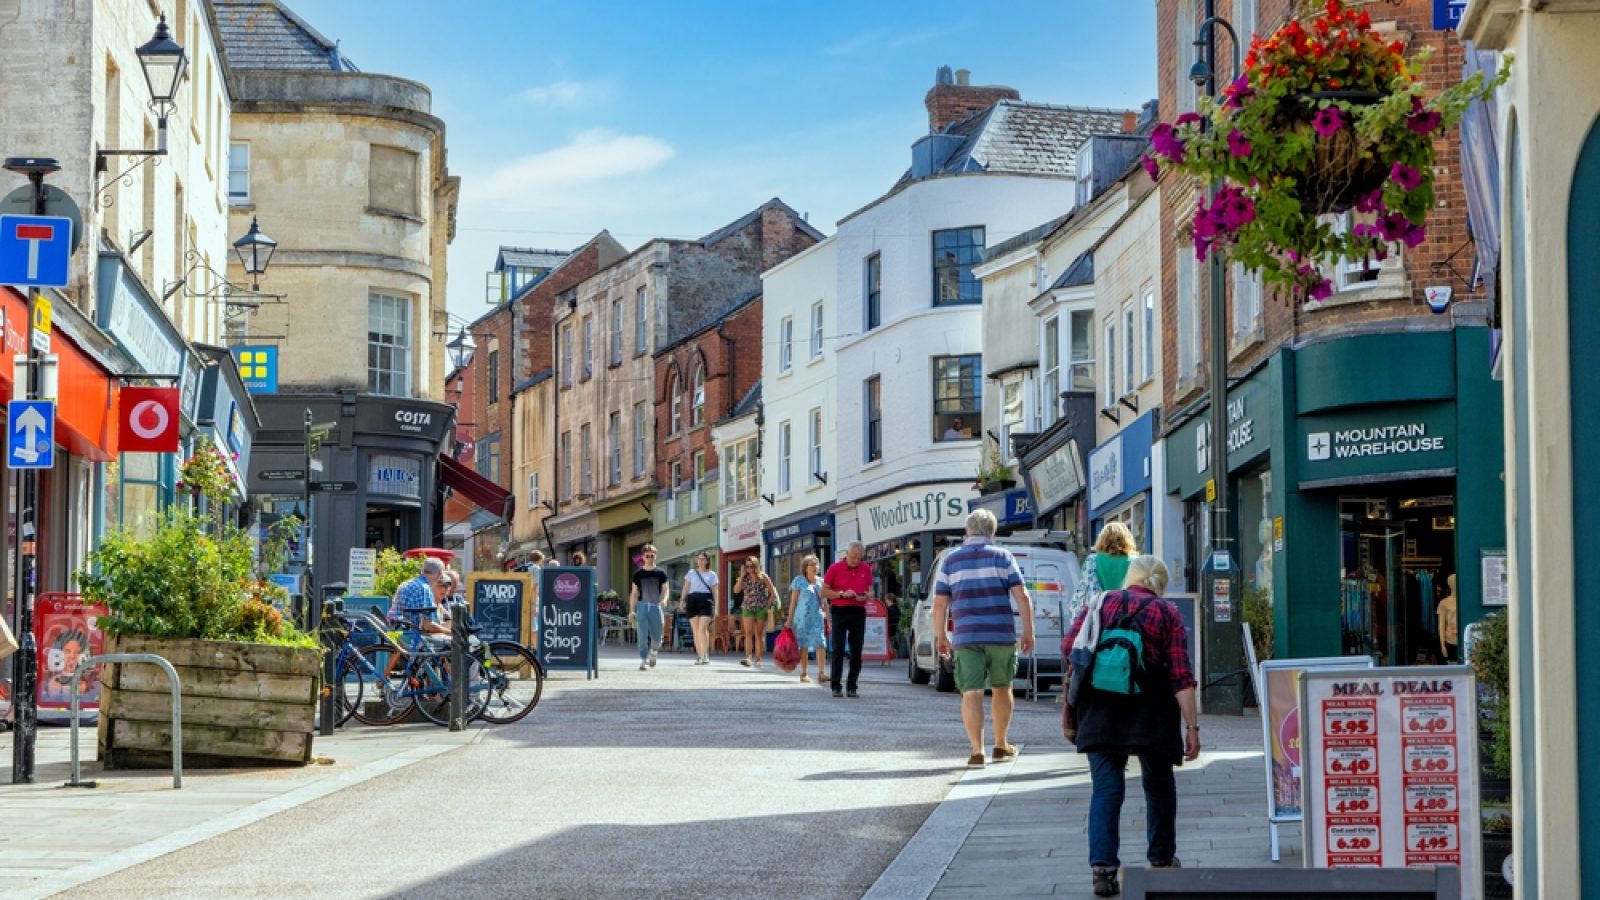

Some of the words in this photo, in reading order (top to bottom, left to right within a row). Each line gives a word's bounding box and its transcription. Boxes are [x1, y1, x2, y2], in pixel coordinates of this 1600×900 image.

[395, 411, 431, 424] COSTA
[1335, 423, 1425, 443] MOUNTAIN
[1335, 437, 1444, 458] WAREHOUSE
[869, 492, 963, 531] Woodruffs
[483, 584, 516, 599] YARD
[543, 604, 582, 626] Wine
[543, 627, 581, 654] Shop
[1332, 682, 1385, 696] MEAL
[1392, 680, 1453, 695] DEALS
[1331, 720, 1368, 734] 5.95
[1409, 718, 1447, 733] 6.40
[1331, 759, 1370, 775] 6.40
[1411, 758, 1448, 771] 5.60
[1336, 800, 1369, 813] 4.80
[1414, 798, 1448, 812] 4.80
[1337, 838, 1371, 849] 6.20
[1416, 837, 1448, 851] 4.95
